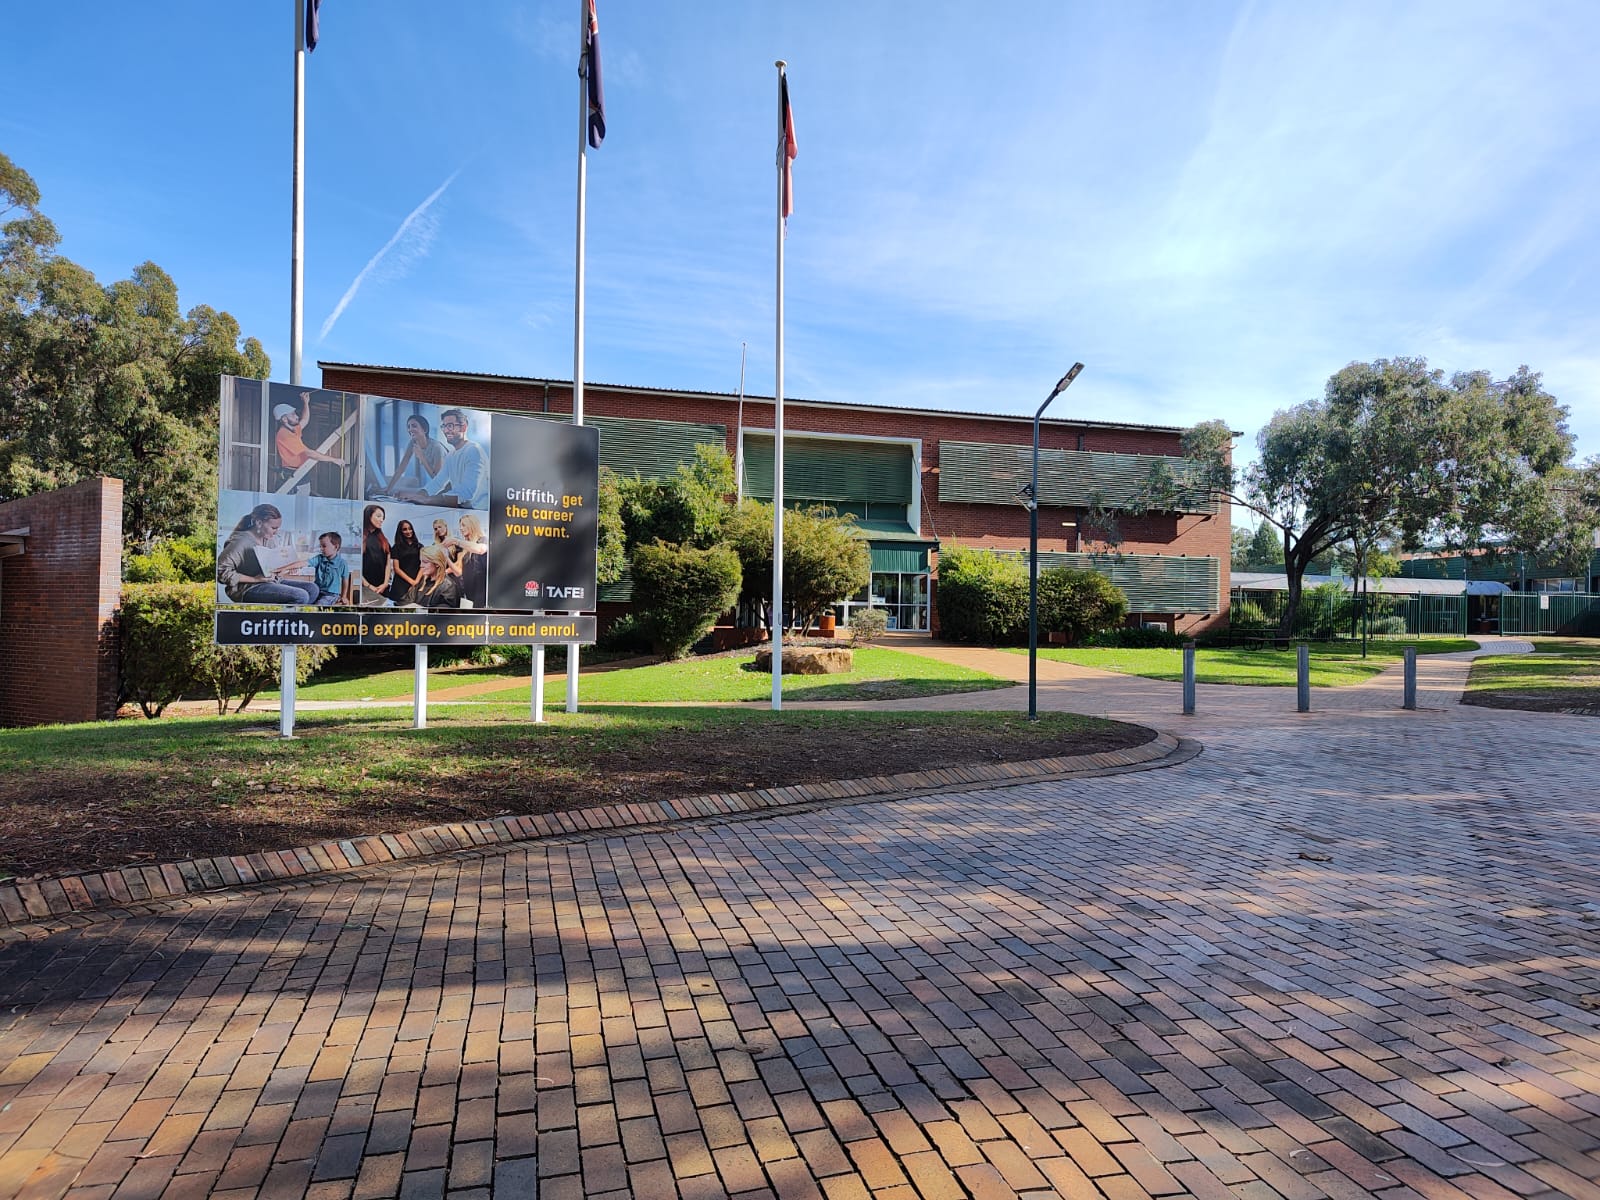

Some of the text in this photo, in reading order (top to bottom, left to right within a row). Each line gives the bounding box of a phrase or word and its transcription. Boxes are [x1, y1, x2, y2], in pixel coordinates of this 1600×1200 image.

[506, 487, 583, 508] Griffith, get
[505, 504, 574, 522] the career
[505, 523, 570, 538] you want.
[546, 586, 580, 598] TAFE
[240, 619, 315, 638] Griffith,
[321, 623, 368, 636] come
[373, 620, 441, 639] explore,
[509, 622, 536, 637] and
[540, 623, 580, 637] enrol.
